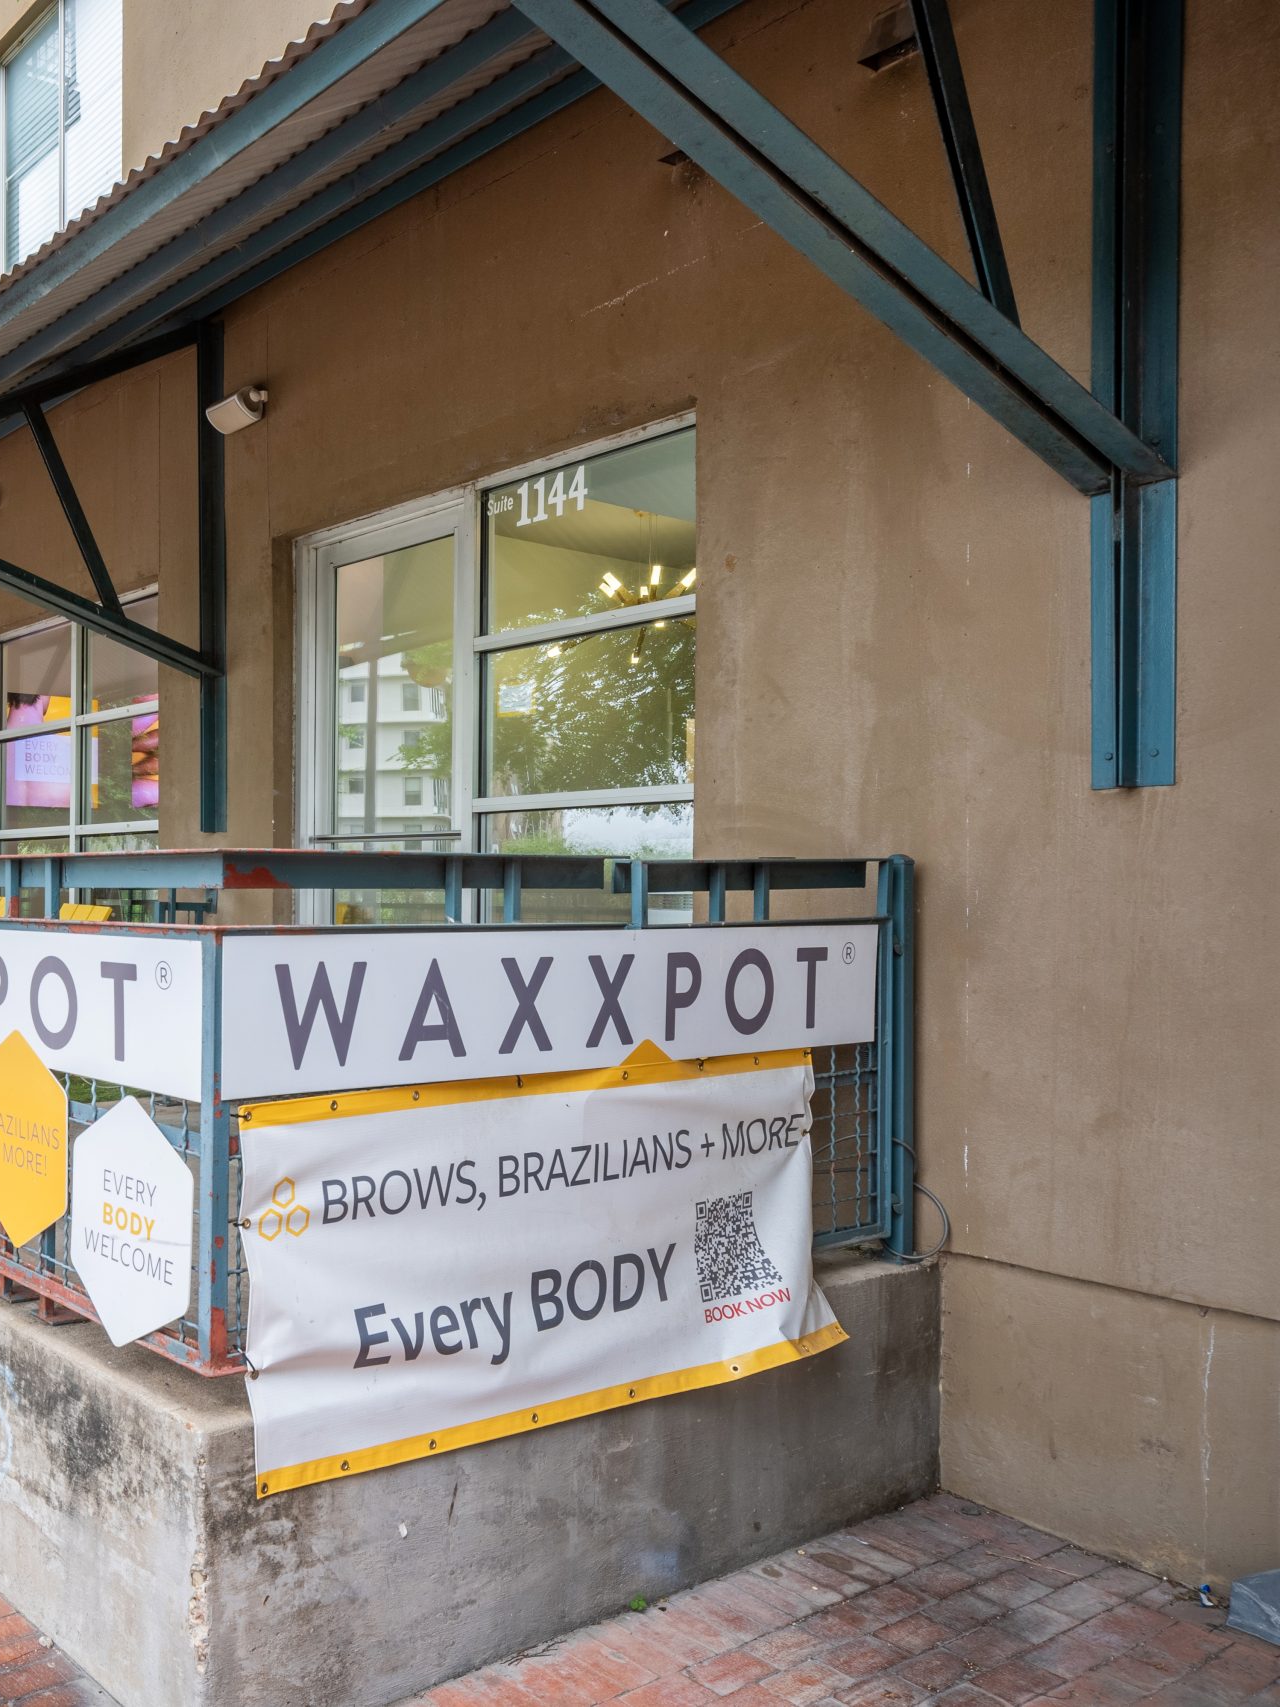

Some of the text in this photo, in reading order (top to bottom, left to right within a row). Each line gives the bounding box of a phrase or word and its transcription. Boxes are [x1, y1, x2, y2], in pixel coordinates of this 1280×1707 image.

[487, 465, 588, 527] Suite 1144
[24, 752, 58, 763] BODY
[274, 946, 829, 1071] WAXXPOT
[3, 1142, 47, 1176] MORE!
[320, 1159, 487, 1226] BROWS,
[498, 1130, 693, 1199] BRAZILIANS
[721, 1112, 806, 1161] MORE
[103, 1168, 157, 1207] EVERY
[102, 1201, 155, 1241] BODY
[84, 1226, 174, 1286] WELCOME
[352, 1242, 678, 1369] Every BODY
[704, 1287, 791, 1324] BOOK NOW
